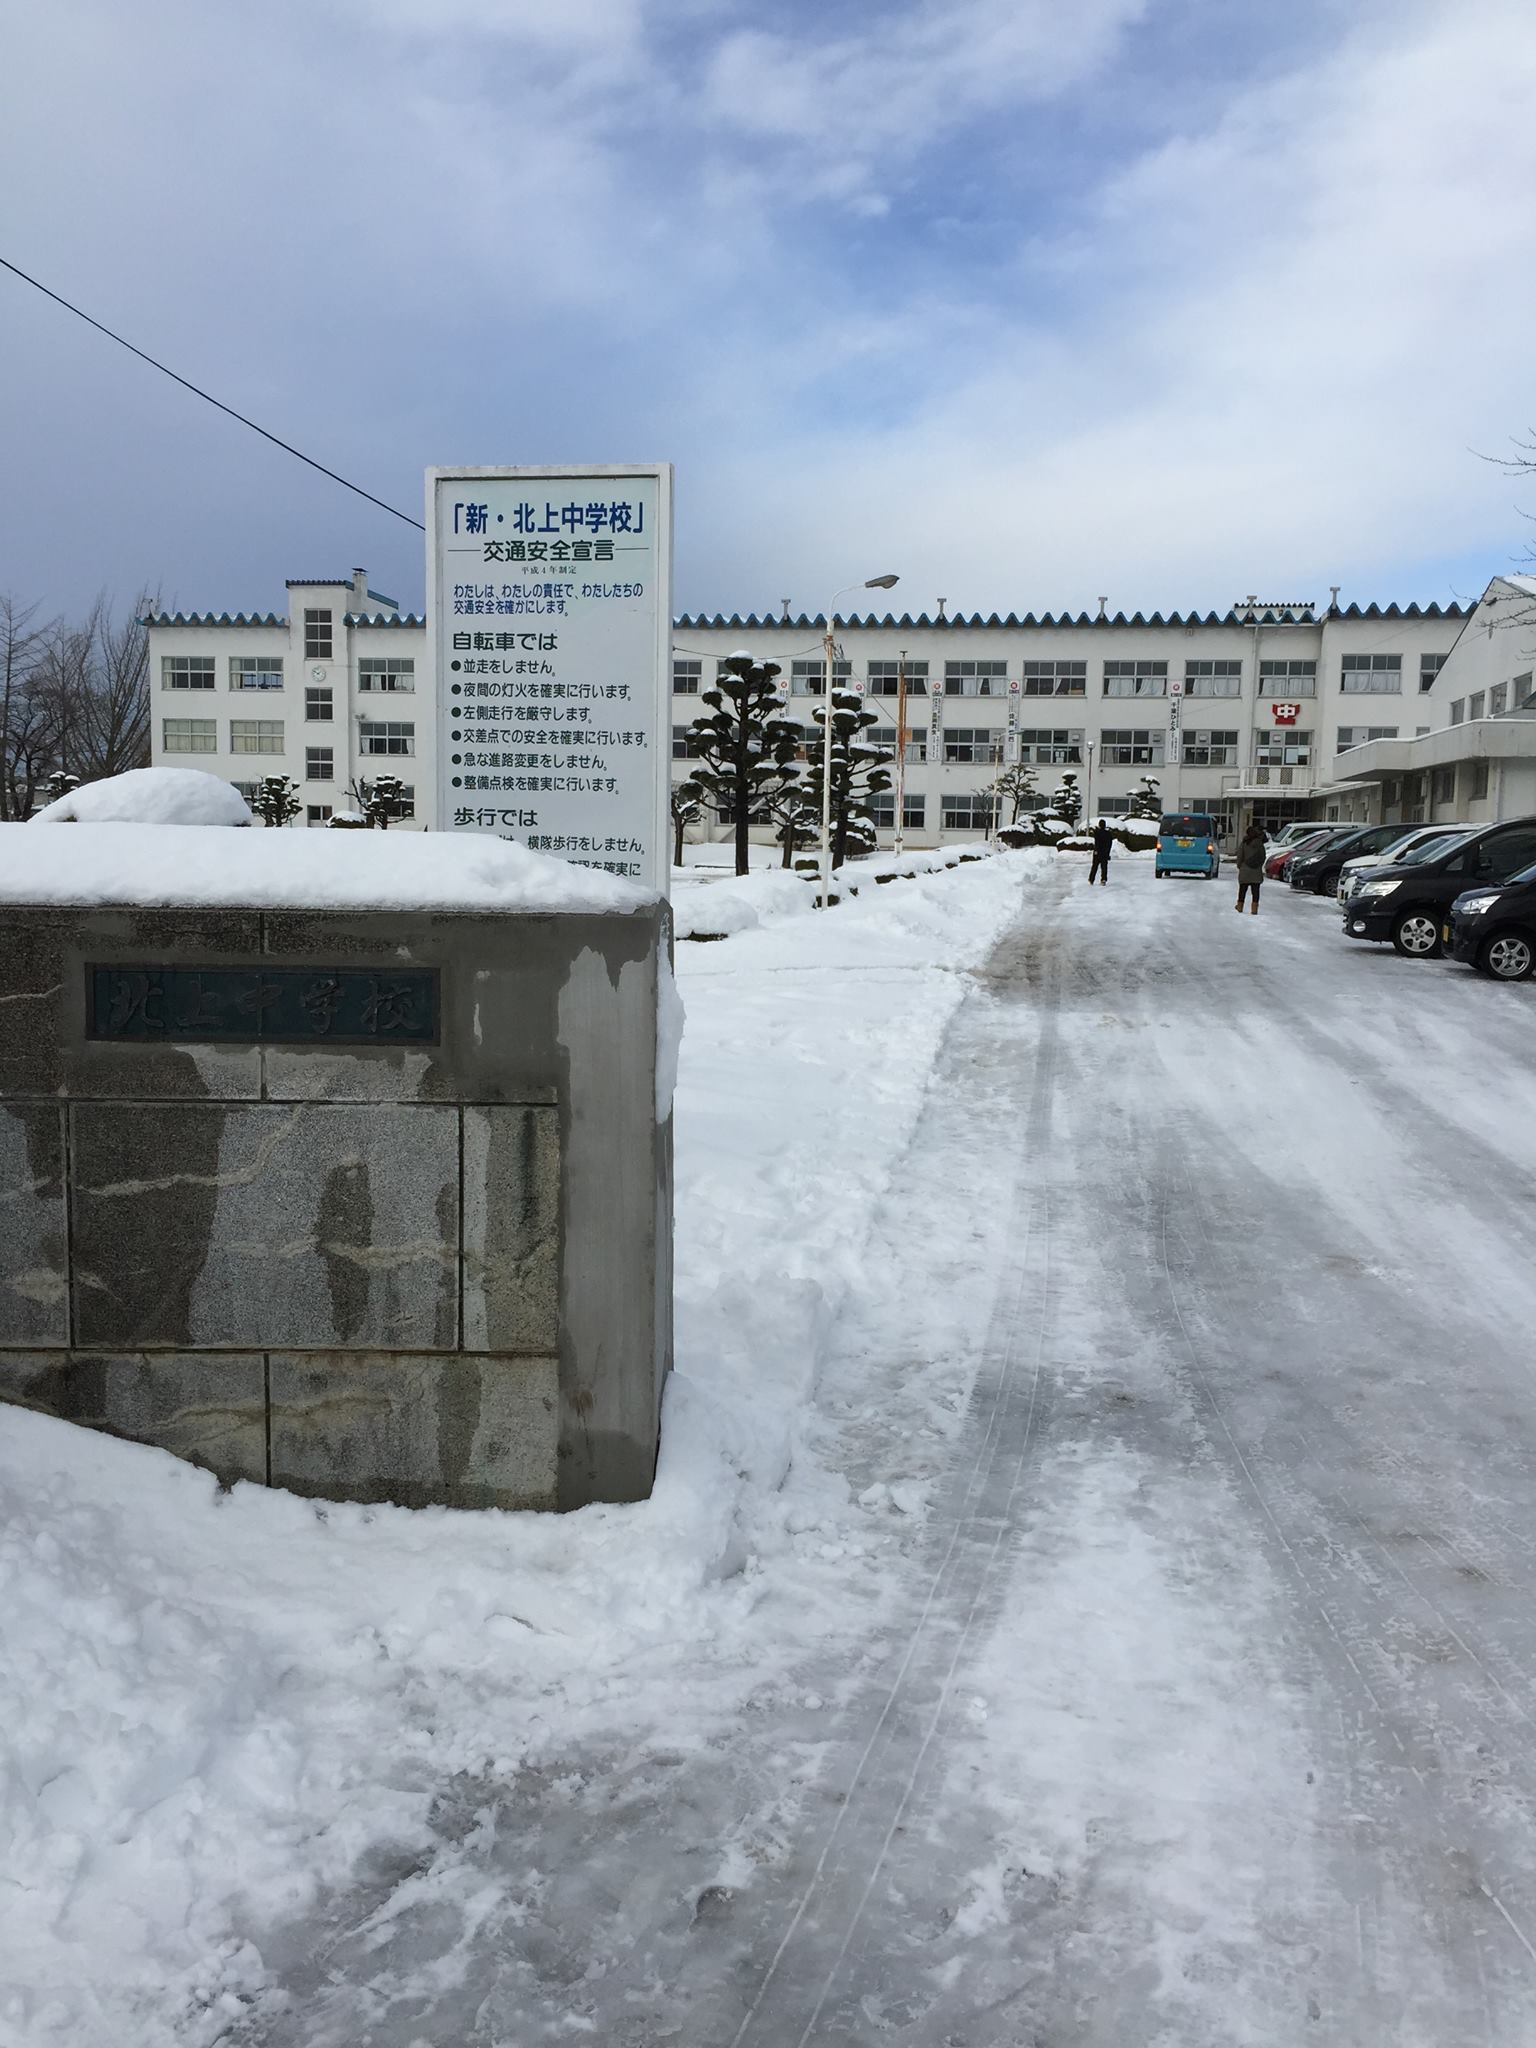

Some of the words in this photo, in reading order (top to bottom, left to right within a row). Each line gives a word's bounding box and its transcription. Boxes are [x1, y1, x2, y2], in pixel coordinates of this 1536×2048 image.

[453, 502, 644, 534] 「新・北上中学校」
[483, 539, 615, 562] 交通安全宣言
[453, 583, 644, 600] わたしは、わたしの責任で、わたしたちの
[453, 600, 569, 617] 交通安全を確かにします。
[453, 632, 558, 651] 自転車では
[463, 659, 556, 677] 並走をしません。
[463, 682, 632, 701] 夜間の灯火を確実に行います。
[463, 706, 592, 724] 左側走行を厳守します。
[463, 729, 648, 749] 交差点での安全を確実に行います。
[463, 752, 608, 772] 急な進路変更をしません。
[463, 775, 620, 795] 整備点検を確実に行います。
[453, 807, 539, 827] 歩行では
